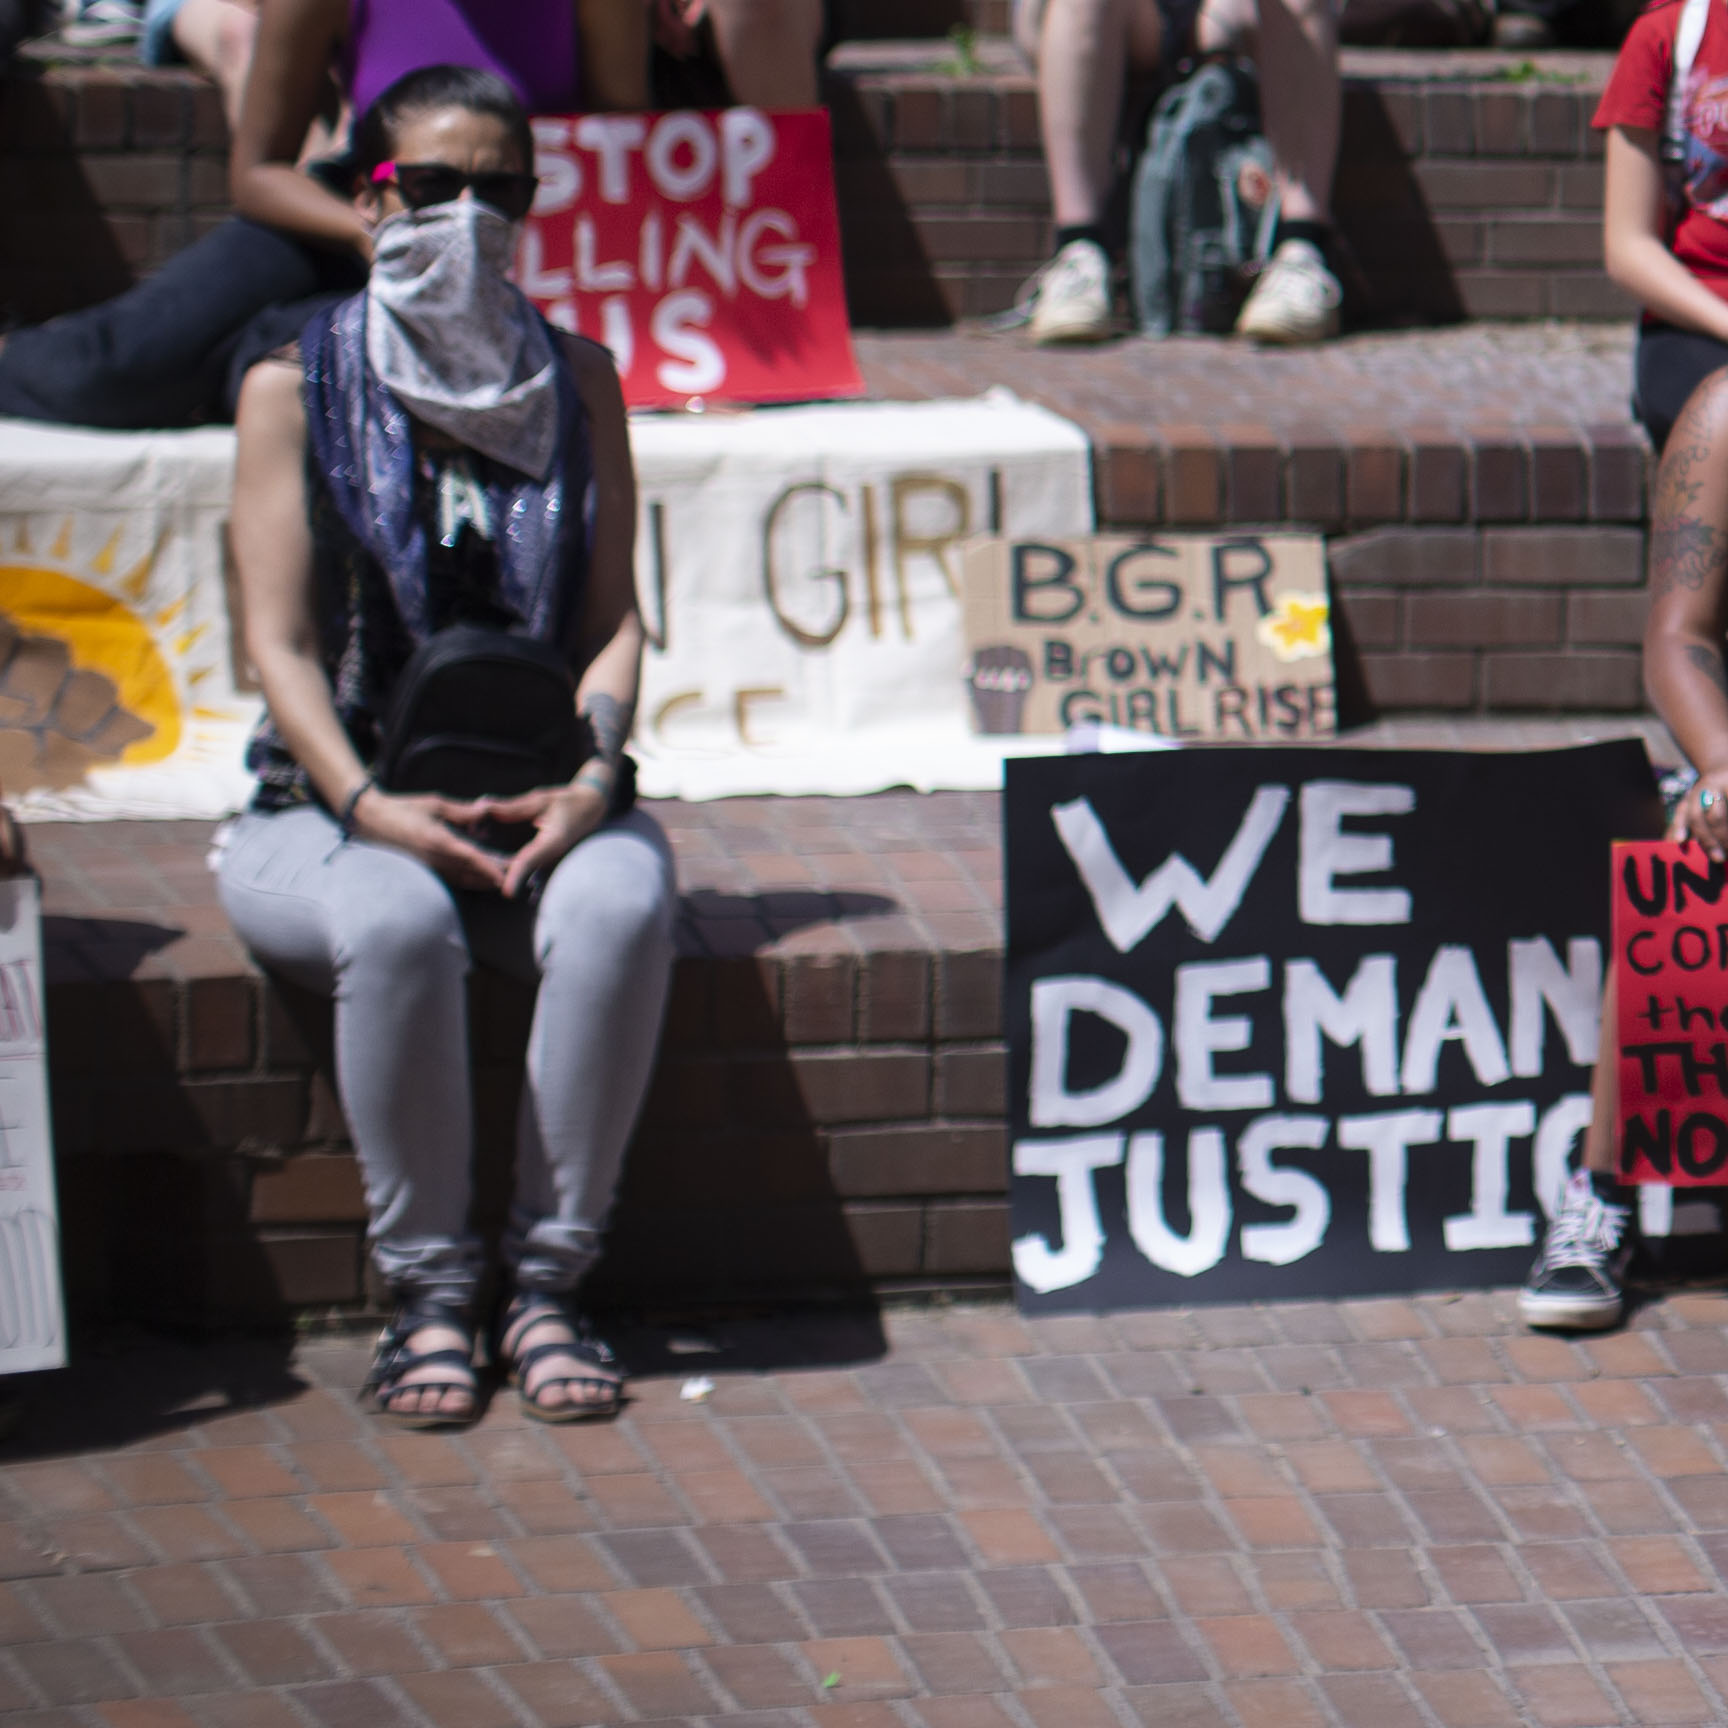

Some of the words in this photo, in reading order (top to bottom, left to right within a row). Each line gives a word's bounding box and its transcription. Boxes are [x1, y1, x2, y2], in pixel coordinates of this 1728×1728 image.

[530, 110, 778, 214] STOP
[516, 207, 818, 308] LLING
[1060, 688, 1200, 738] GIRL
[1215, 681, 1338, 740] RISE
[1050, 779, 1418, 954] WE
[1029, 936, 1602, 1128] DEMAN
